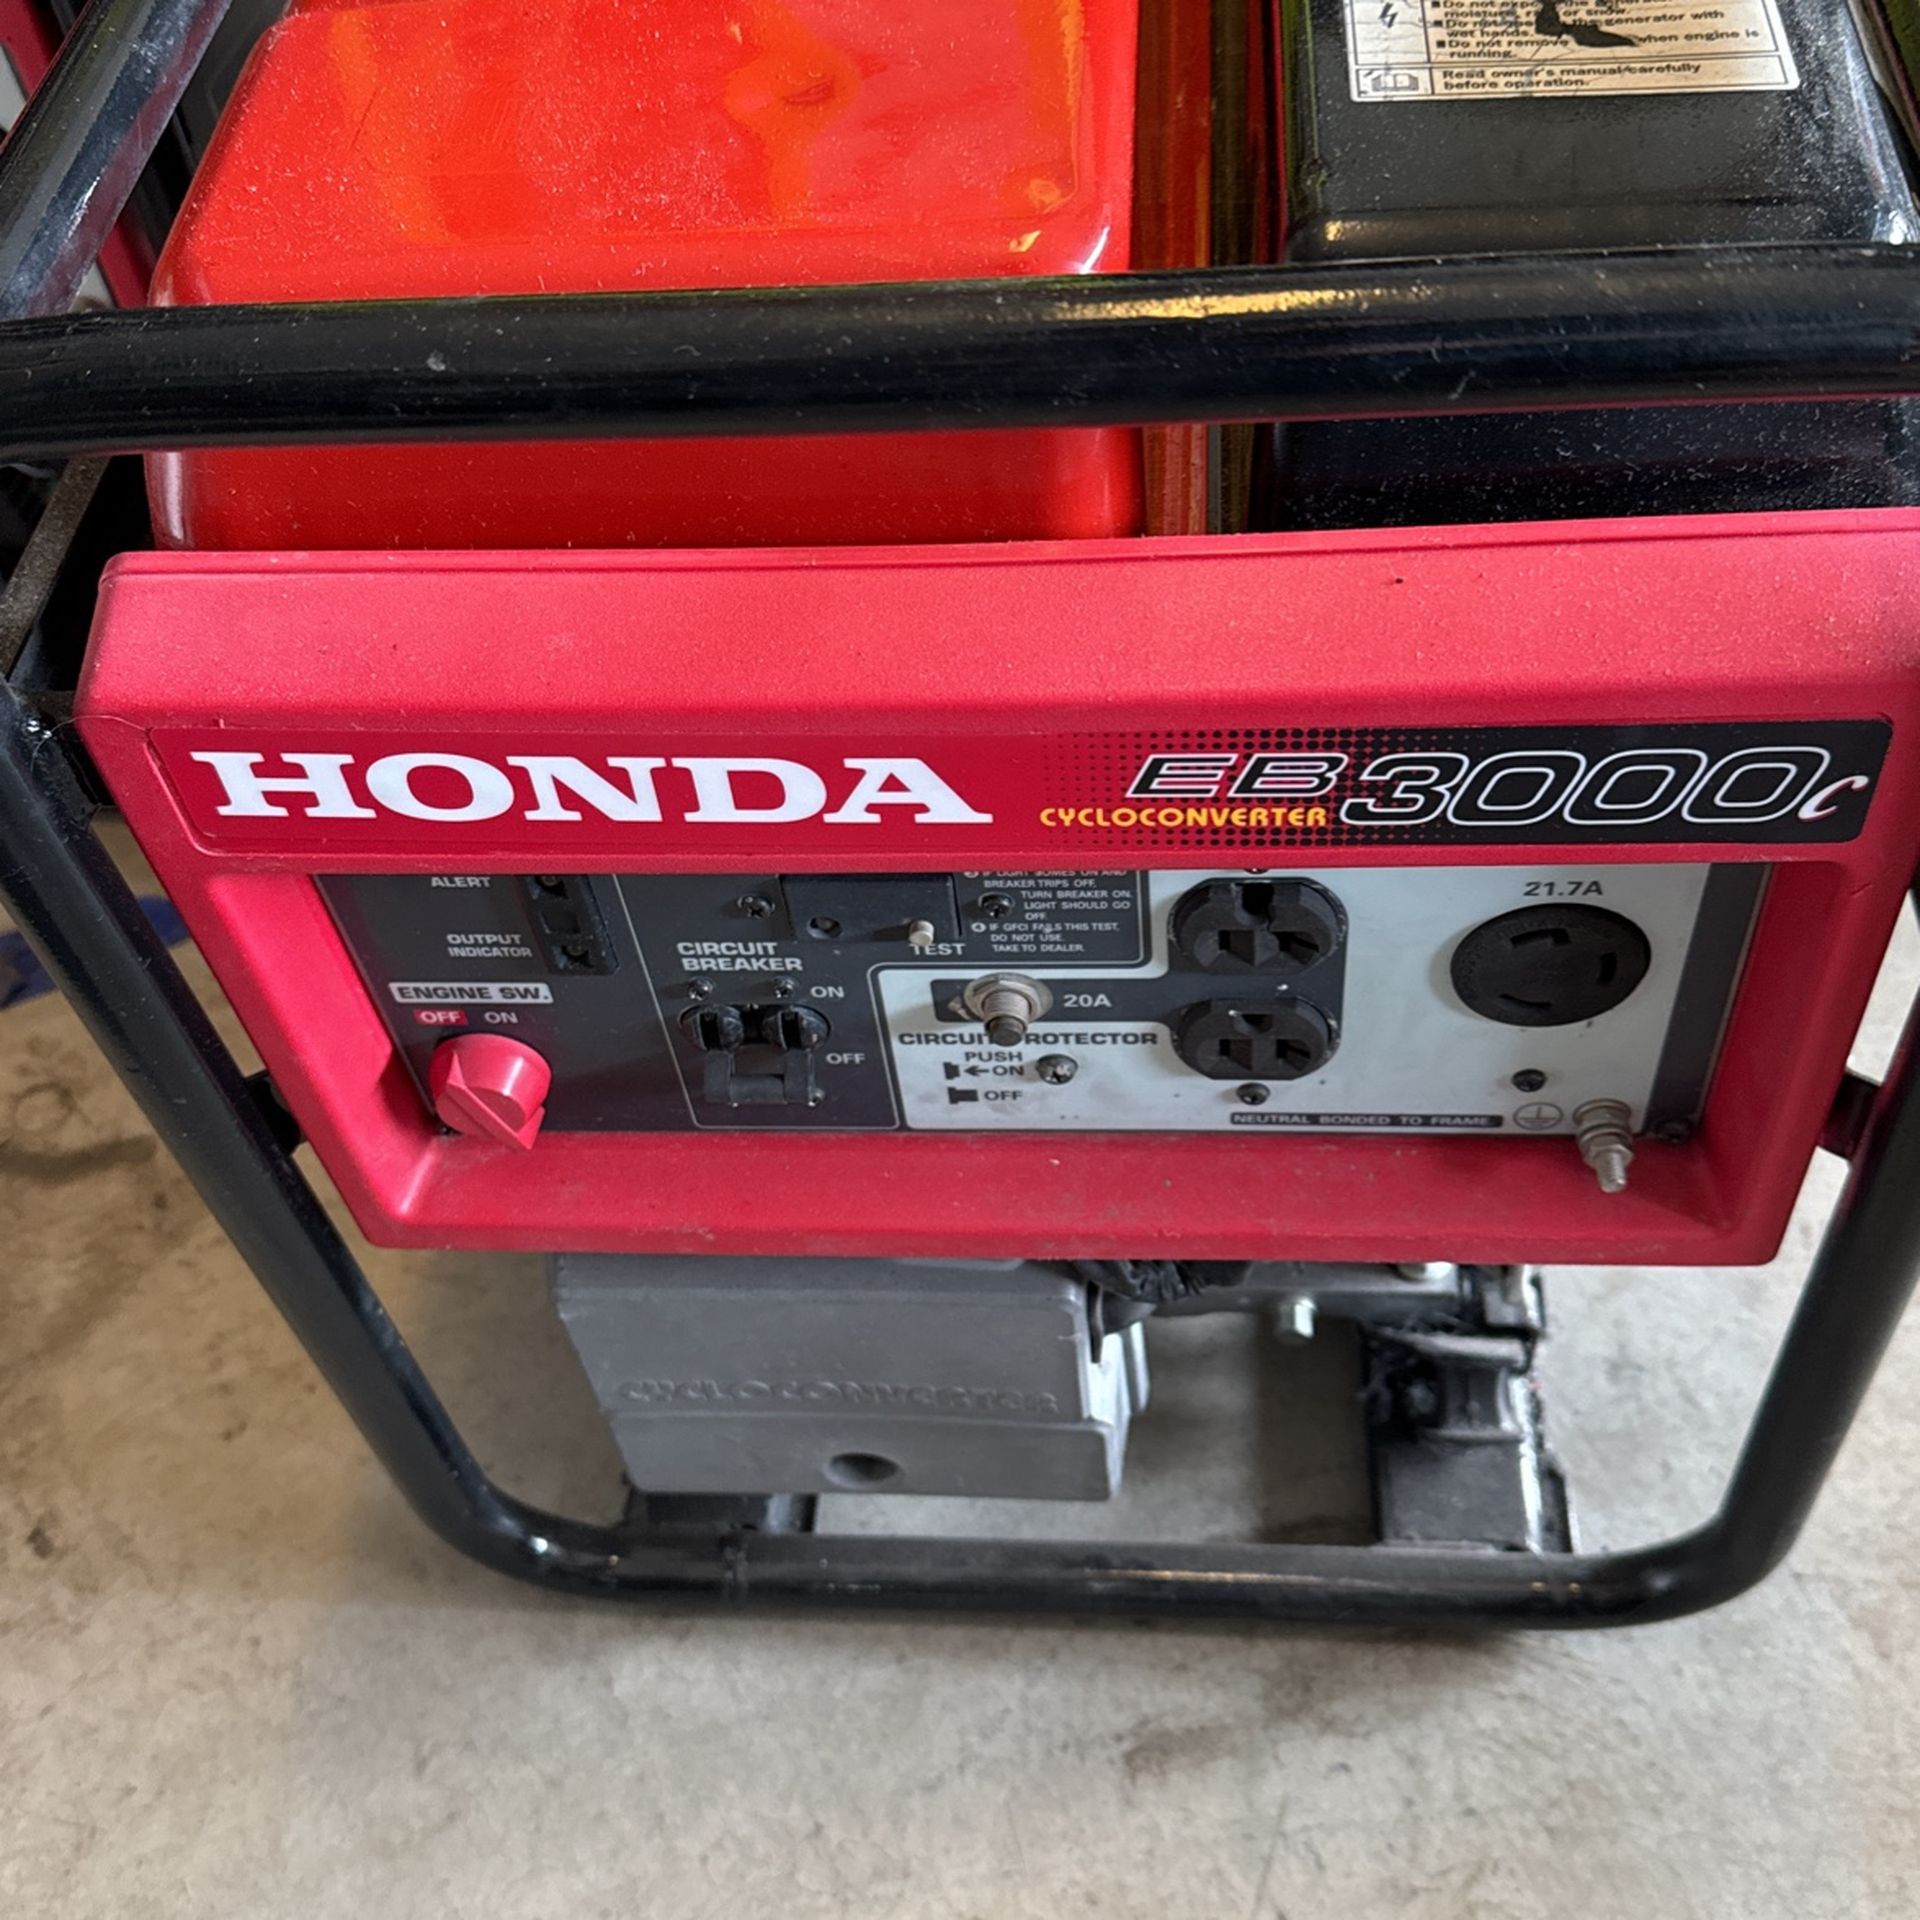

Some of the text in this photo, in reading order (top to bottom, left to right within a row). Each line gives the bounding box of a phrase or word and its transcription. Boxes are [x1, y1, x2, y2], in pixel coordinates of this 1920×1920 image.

[1446, 20, 1468, 28] Do
[1604, 14, 1684, 26] generator
[1691, 10, 1725, 20] with
[1563, 9, 1580, 17] or
[1446, 28, 1536, 38] wet hands.
[1449, 40, 1470, 48] Do
[1475, 39, 1502, 48] not
[1507, 39, 1569, 48] remove
[1684, 29, 1740, 41] engine
[1746, 28, 1760, 38] is
[1450, 50, 1518, 60] running.
[1442, 69, 1485, 79] Read
[1491, 66, 1555, 79] owner's
[1560, 63, 1623, 76] manual
[1444, 79, 1499, 91] before
[190, 751, 995, 825] HONDA
[1040, 807, 1327, 828] CYCLOCONVERTER
[431, 876, 491, 888] ALERT
[984, 879, 1036, 888] BREAKER
[1039, 879, 1070, 888] TRIPS
[1020, 890, 1053, 899] TURN
[1057, 890, 1109, 899] BREAKER
[1523, 880, 1604, 897] 21.7A
[1024, 901, 1131, 910] LIGHT SHOULD GO
[989, 923, 1000, 931] IF
[1003, 923, 1029, 931] GFCI
[1065, 923, 1090, 931] THIS
[446, 934, 522, 945] OUTPUT
[991, 934, 1008, 942] DO
[1012, 933, 1035, 942] NOT
[448, 947, 533, 958] INDICATOR
[676, 941, 778, 956] CIRCUIT
[909, 942, 966, 956] TEST
[992, 944, 1020, 953] TAKE
[1023, 944, 1037, 953] TO
[681, 957, 804, 972] BREAKER
[397, 986, 549, 1000] ENGINE SW.
[810, 986, 845, 998] ON
[1063, 993, 1112, 1008] 20A
[419, 1011, 462, 1024] OFF
[484, 1011, 519, 1024] ON
[1024, 1032, 1159, 1046] ROTECTOR
[826, 1052, 866, 1065] OFF
[965, 1051, 1023, 1062] PUSH
[992, 1065, 1025, 1076] ON
[984, 1090, 1023, 1102] OFF
[1233, 1113, 1491, 1127] NEUTRAL BONDED TO FRAME
